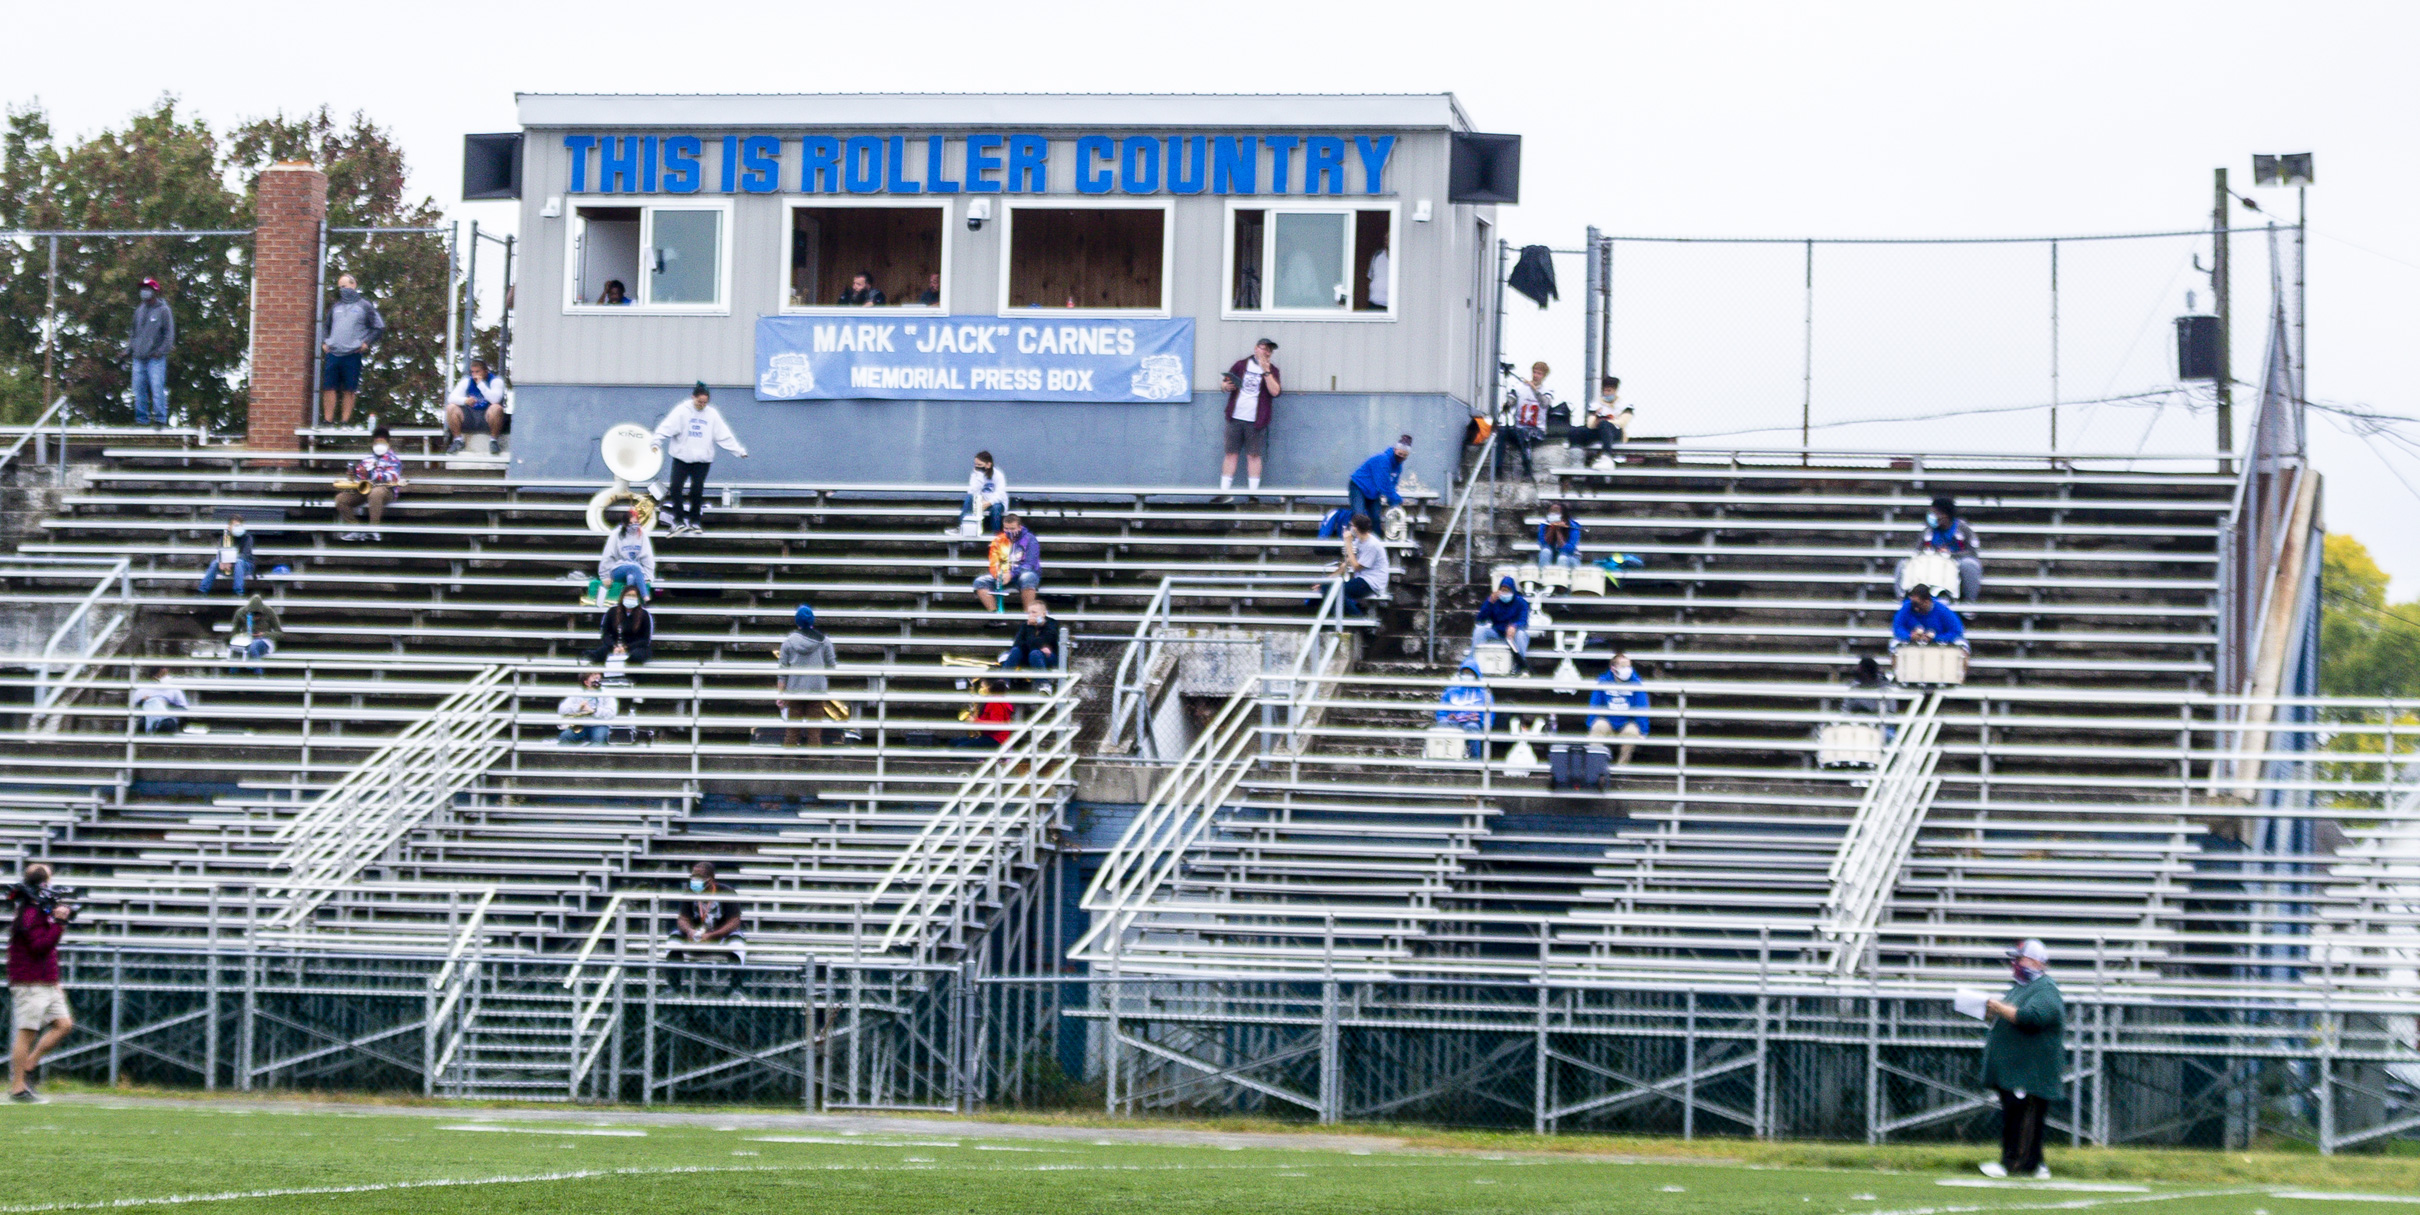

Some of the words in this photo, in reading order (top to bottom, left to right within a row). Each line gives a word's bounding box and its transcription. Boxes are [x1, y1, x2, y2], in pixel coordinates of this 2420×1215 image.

[563, 134, 702, 194] THIS
[720, 134, 781, 194] IS
[801, 134, 1048, 194] ROLLER
[1075, 135, 1398, 196] COUNTRY
[813, 325, 895, 353] MARK
[904, 325, 1010, 354] "JACK"
[1017, 326, 1135, 356] CARNES
[851, 366, 965, 390] MEMORIAL
[970, 368, 1042, 391] PRESS
[1047, 369, 1094, 392] BOX
